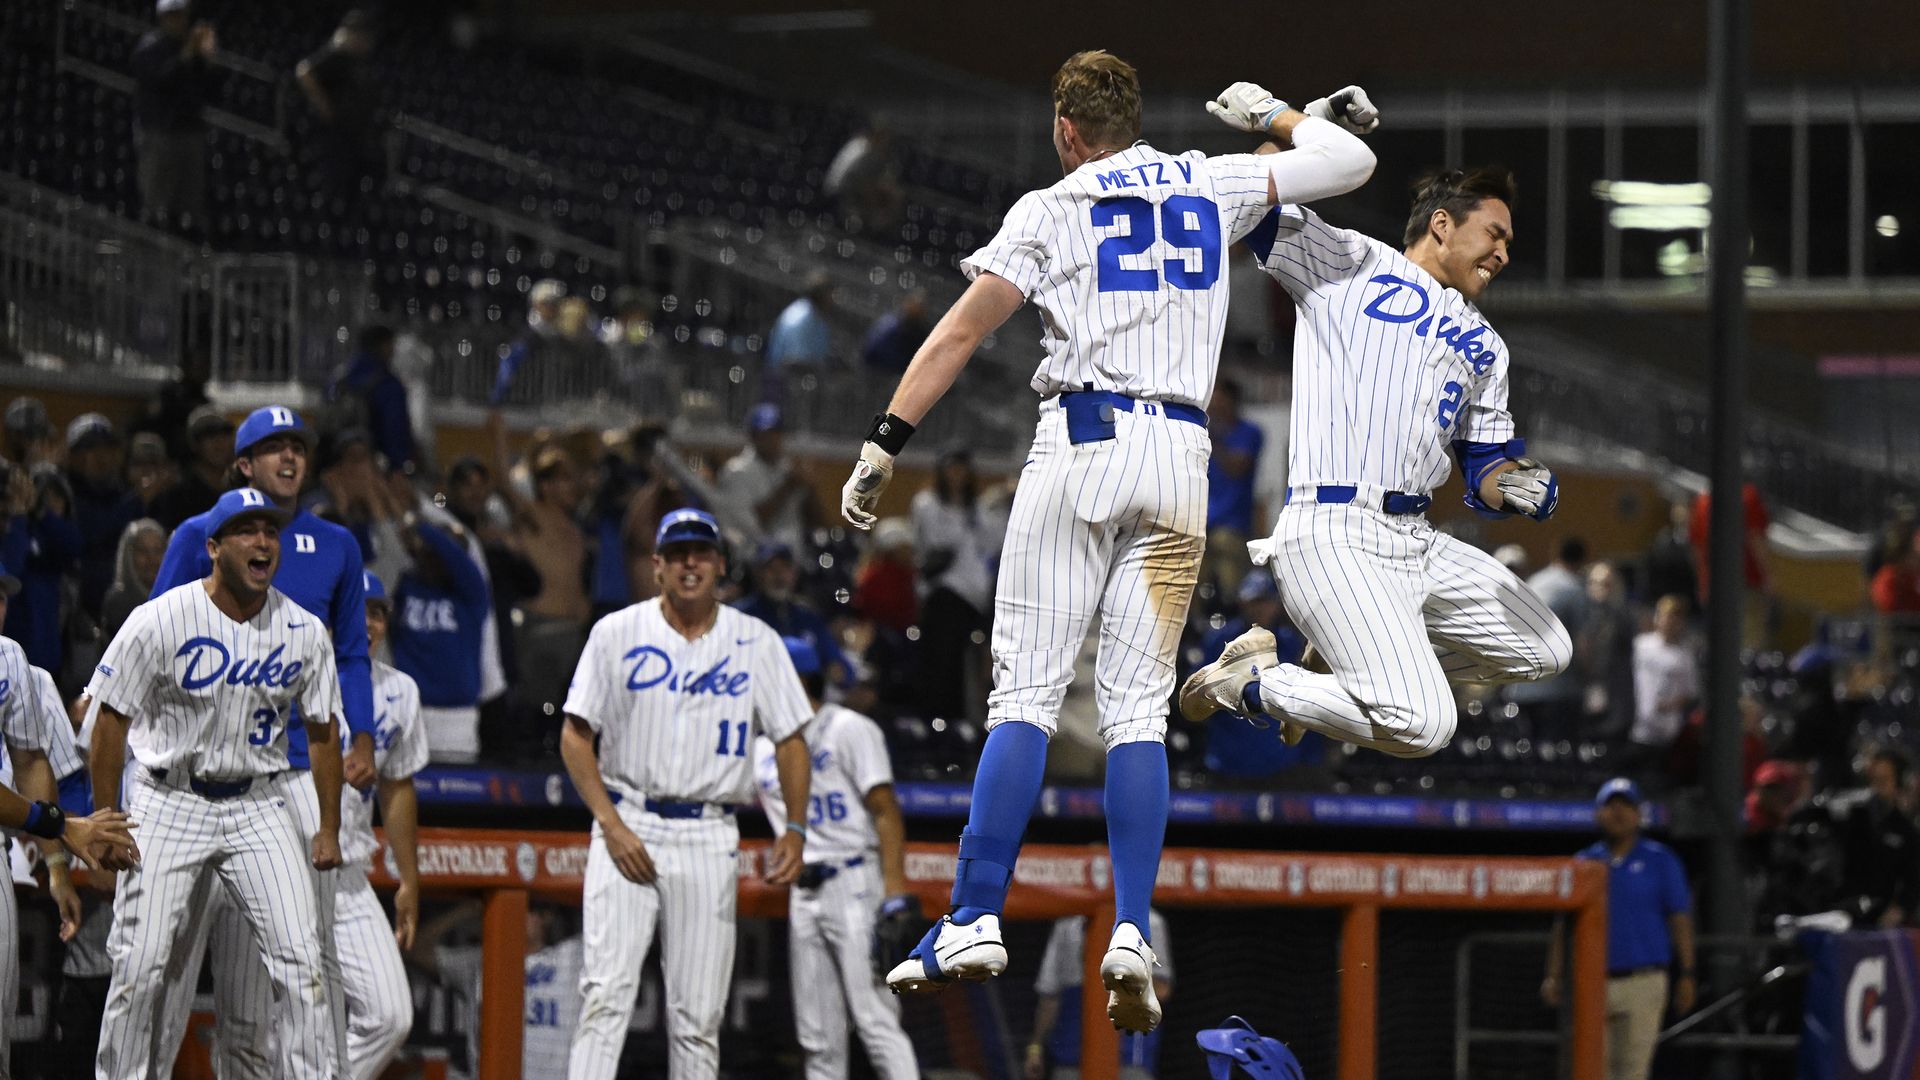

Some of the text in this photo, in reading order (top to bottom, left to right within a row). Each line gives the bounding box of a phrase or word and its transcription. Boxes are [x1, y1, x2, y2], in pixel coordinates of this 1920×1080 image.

[1096, 160, 1192, 191] METZ V
[1090, 194, 1221, 293] 29
[1363, 273, 1496, 376] Duke
[270, 406, 294, 427] D
[1438, 380, 1469, 432] 2
[239, 487, 265, 507] D
[294, 533, 316, 553] D
[175, 635, 303, 690] Duke
[622, 645, 750, 697] Duke
[248, 707, 278, 746] 3
[715, 719, 749, 757] 11
[808, 791, 848, 826] 36
[416, 843, 510, 877] GATORADE
[1844, 956, 1887, 1072] G
